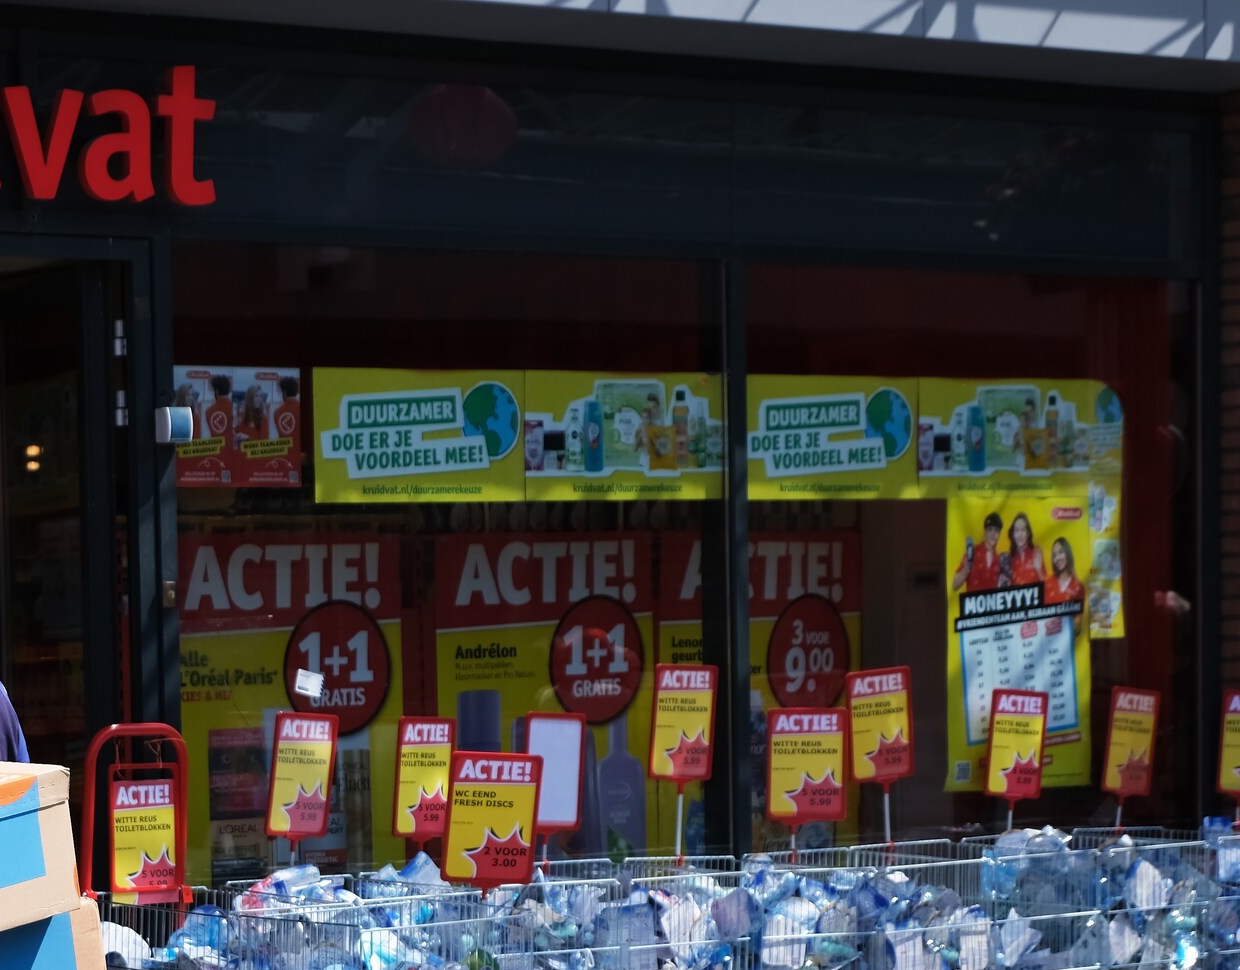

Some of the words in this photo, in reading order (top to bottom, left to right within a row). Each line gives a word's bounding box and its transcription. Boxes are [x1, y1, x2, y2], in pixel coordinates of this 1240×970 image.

[351, 400, 454, 425] DUURZAMER
[768, 405, 858, 427] DUURZAMER
[331, 432, 364, 451] DOE
[369, 431, 390, 449] ER
[394, 430, 413, 448] JE
[751, 435, 781, 452] DOE
[785, 433, 802, 449] ER
[805, 432, 821, 448] JE
[355, 449, 441, 470] VOORDEEL
[445, 445, 484, 464] MEE!
[772, 451, 844, 470] VOORDEEL
[848, 446, 882, 464] MEE!
[362, 484, 483, 498] kruidvat.nl/duurzamerekeuze
[184, 542, 382, 611] ACTIE!
[455, 539, 637, 606] ACTIE!
[679, 540, 844, 603] ATIE!
[964, 586, 1040, 616] MONEYYY!
[791, 618, 804, 645] 3
[806, 631, 830, 645] VOOR
[298, 630, 374, 683] 1+1
[455, 642, 517, 659] Andrélon
[562, 623, 629, 676] 1+1
[784, 646, 835, 693] 9.00
[572, 678, 622, 698] GRATIS
[661, 670, 711, 689] ACTIE!
[853, 673, 903, 695] ACTIE!
[310, 687, 366, 708] GRATIS
[852, 703, 872, 711] WITTE
[998, 694, 1042, 713] ACTIE!
[1116, 691, 1156, 712] ACTIE!
[775, 713, 838, 731] ACTIE!
[853, 707, 904, 718] TOILETBLOKKEN
[282, 718, 330, 740] ACTIE!
[404, 723, 449, 743] ACTIE!
[278, 748, 298, 756] WITTE
[686, 747, 709, 755] VOOR
[886, 746, 908, 755] VOOR
[277, 756, 327, 765] TOILETBLOKKEN
[884, 756, 902, 765] 5.99
[459, 759, 532, 782] ACTIE!
[116, 784, 170, 805] ACTIE!
[455, 790, 470, 798] WC
[472, 790, 497, 798] EEND
[802, 788, 808, 796] 5
[812, 788, 840, 796] VOOR
[303, 802, 324, 811] VOOR
[424, 803, 446, 811] VOOR
[454, 799, 483, 807] FRESH
[485, 800, 514, 808] DISCS
[810, 798, 832, 806] 5.99
[115, 816, 138, 824] WITTE
[139, 815, 157, 823] REUS
[300, 812, 317, 821] 5.99
[423, 813, 440, 822] 5.99
[115, 823, 171, 832] TOILETBLOKKEN
[484, 847, 490, 855] 2
[494, 847, 527, 857] VOOR
[492, 858, 517, 867] 3.00
[142, 870, 147, 878] 5
[150, 868, 174, 878] VOOR
